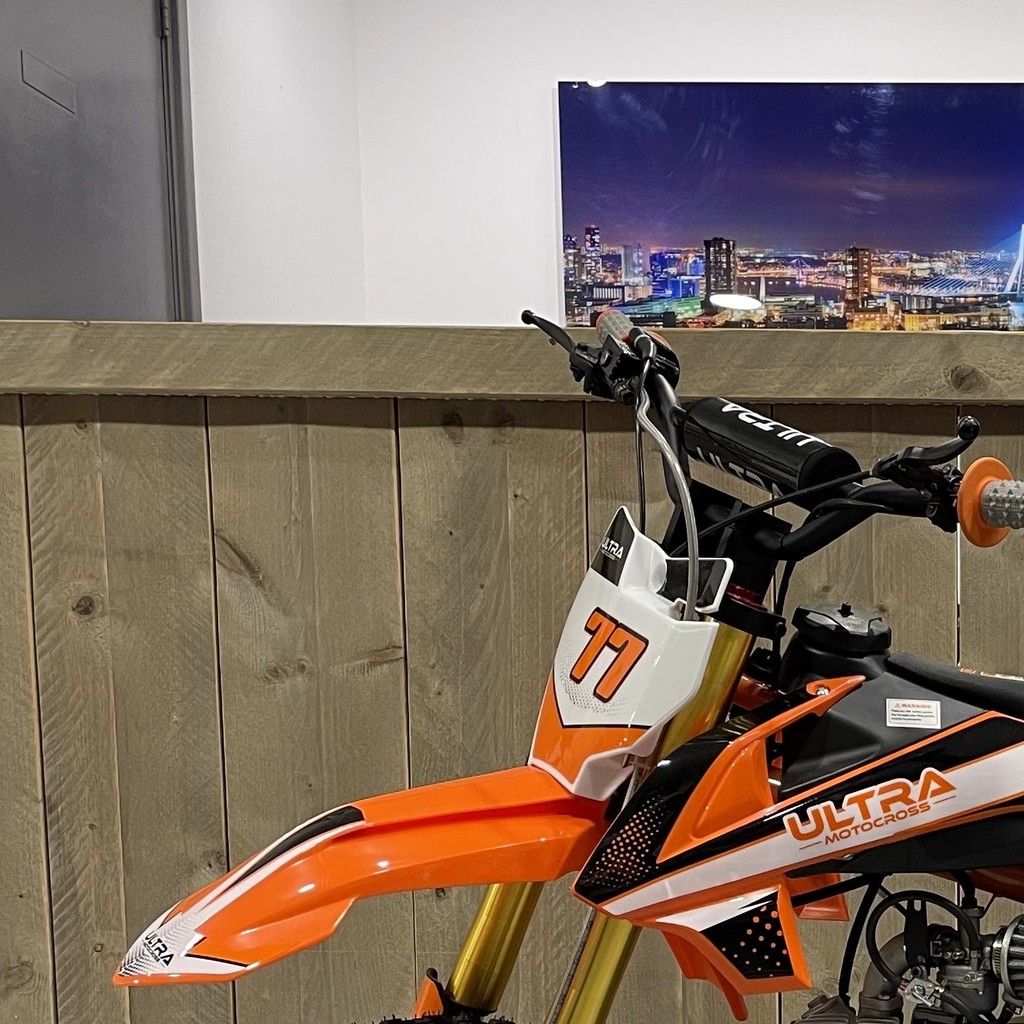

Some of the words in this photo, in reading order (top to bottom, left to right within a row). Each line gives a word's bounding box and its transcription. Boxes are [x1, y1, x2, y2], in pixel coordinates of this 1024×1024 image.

[569, 606, 649, 704] 77
[786, 770, 957, 841] ULTRA
[825, 802, 931, 846] MOTOCROSS
[144, 931, 174, 966] ULTRA
